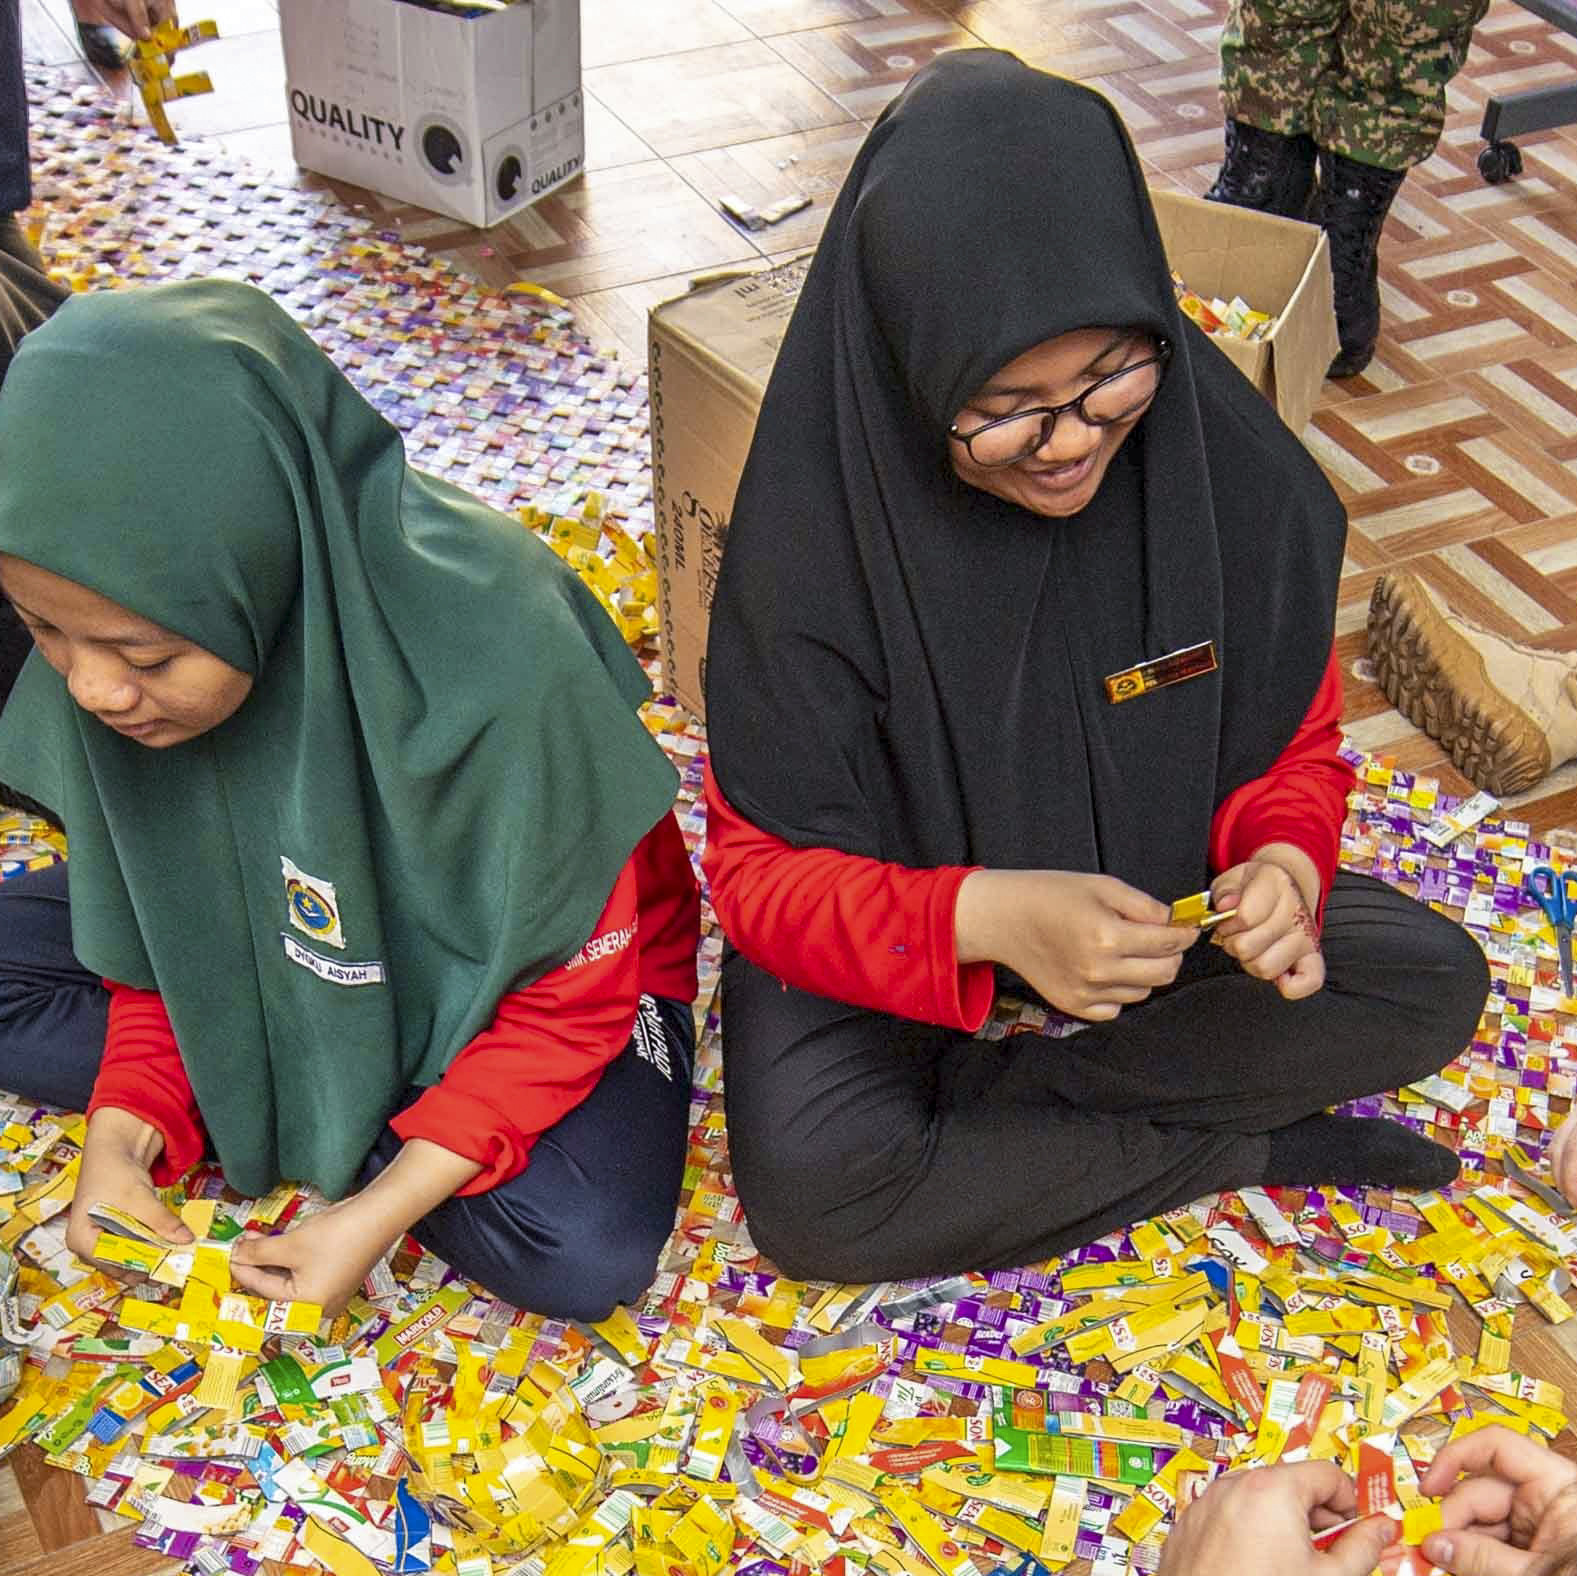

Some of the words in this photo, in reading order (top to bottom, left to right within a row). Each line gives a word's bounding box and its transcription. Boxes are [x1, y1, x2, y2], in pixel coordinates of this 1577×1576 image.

[291, 90, 405, 150] QUALITY
[531, 157, 581, 195] QUALITY
[327, 966, 367, 980] AISYAH
[398, 1307, 445, 1345] MARIGOLD
